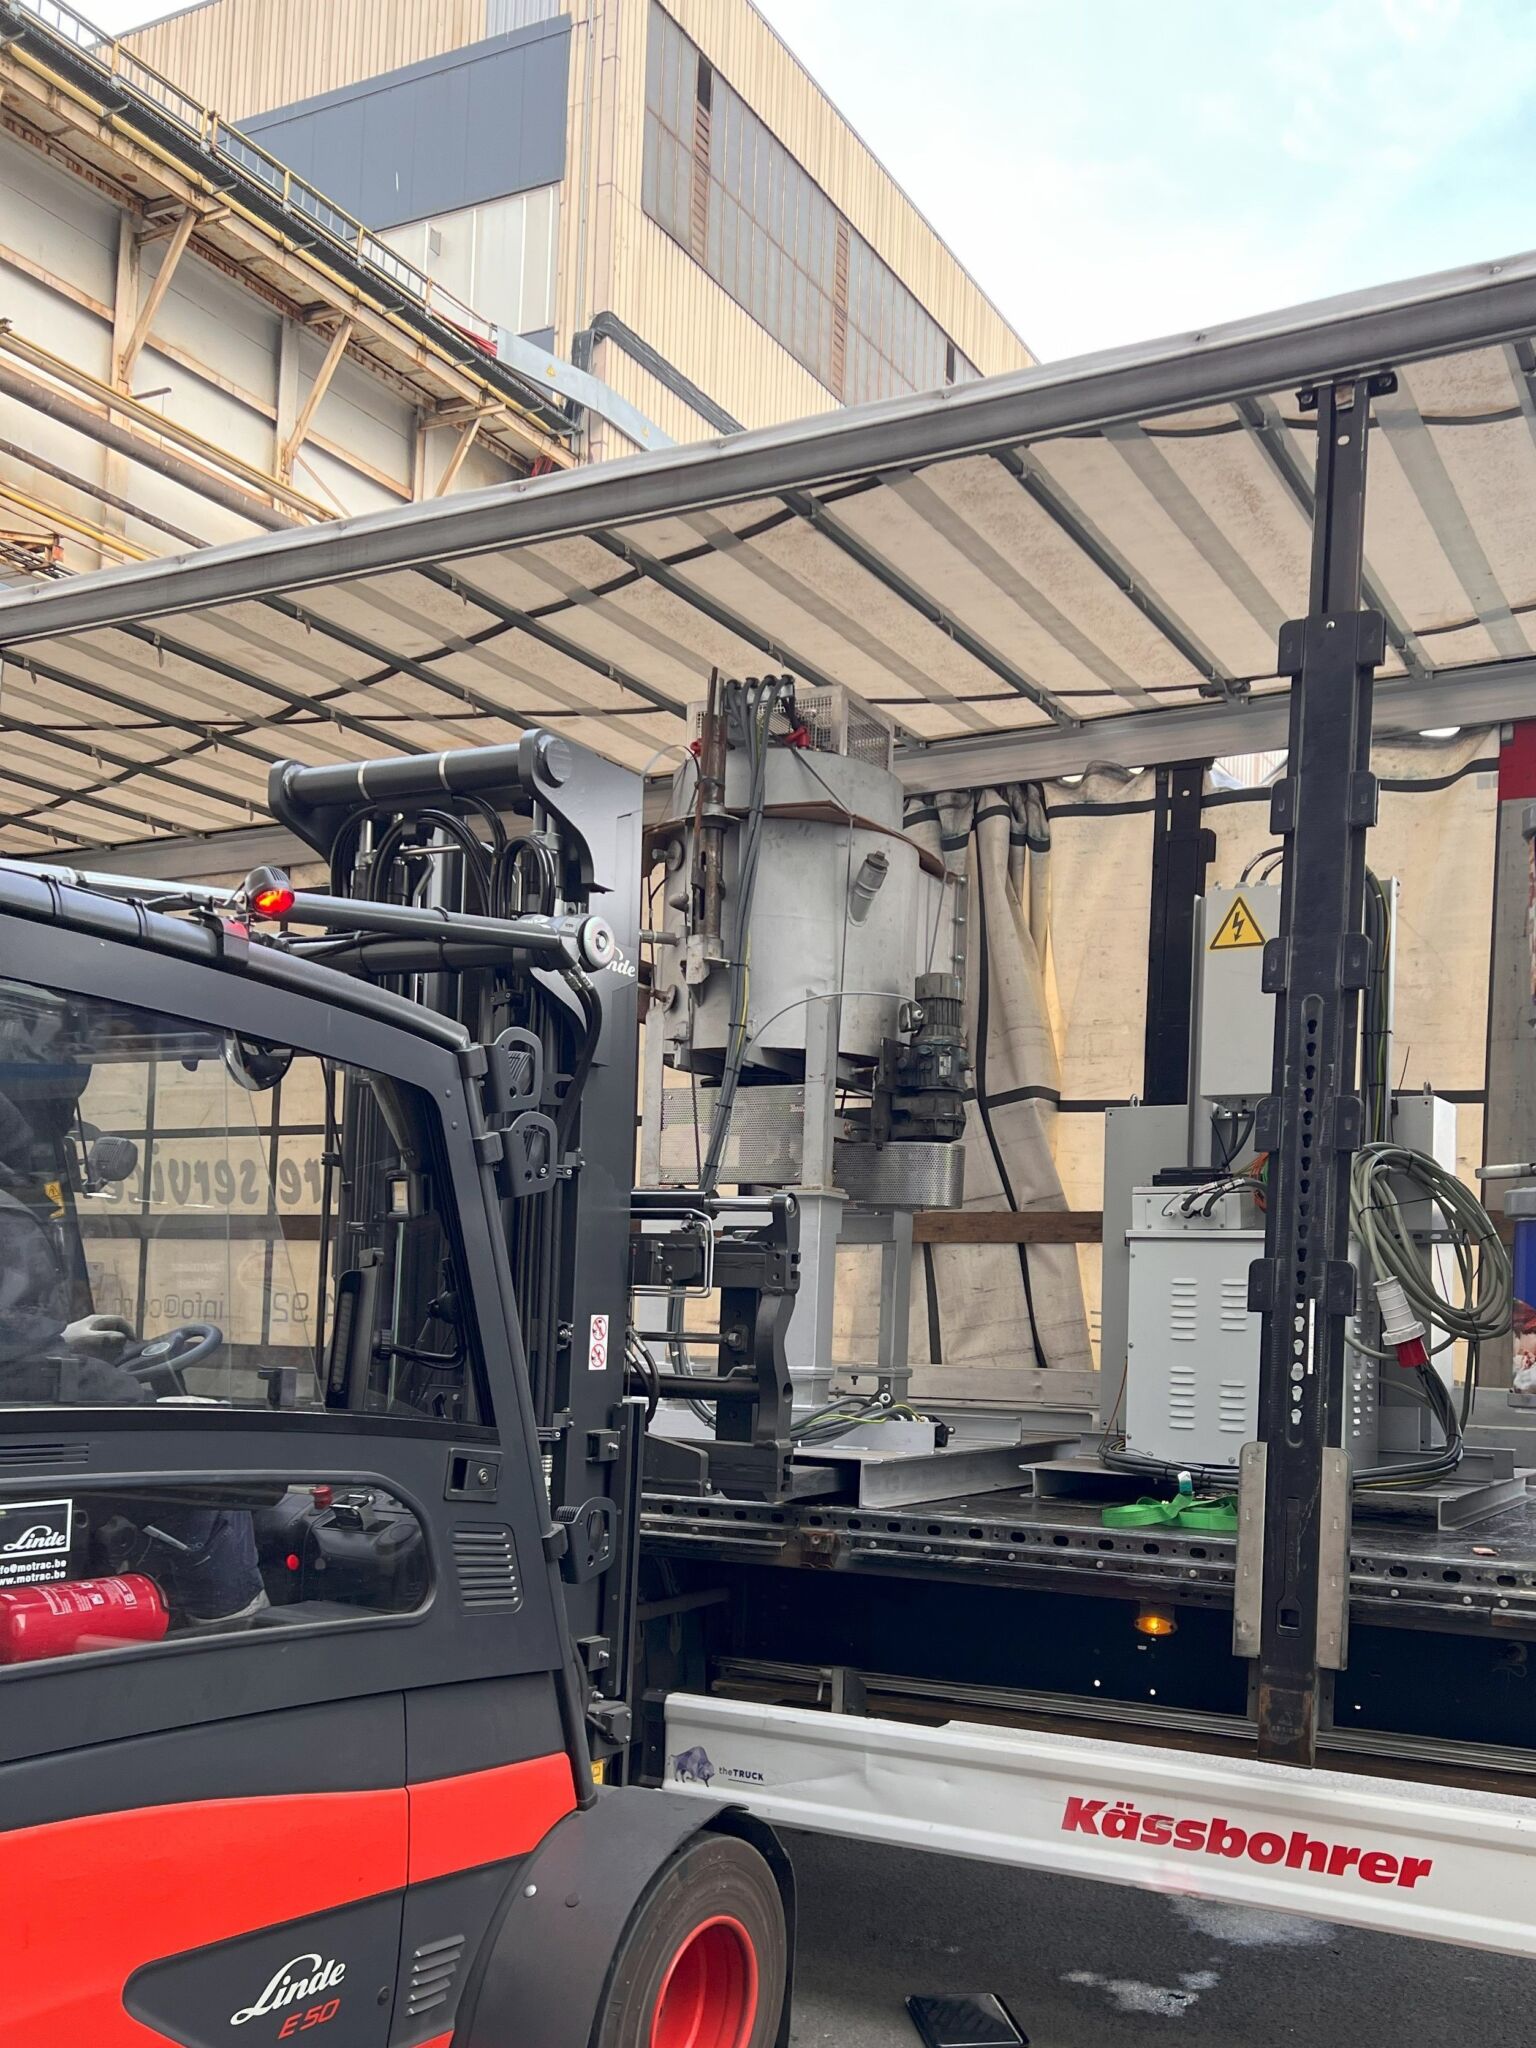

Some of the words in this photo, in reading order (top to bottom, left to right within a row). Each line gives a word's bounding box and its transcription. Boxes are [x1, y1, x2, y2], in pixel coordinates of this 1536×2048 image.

[606, 946, 636, 978] nde
[3, 1525, 66, 1551] Linde
[0, 1558, 67, 1575] fo@motrac.be
[1060, 1796, 1433, 1889] Kässbohrer
[230, 1953, 346, 2026] Linde
